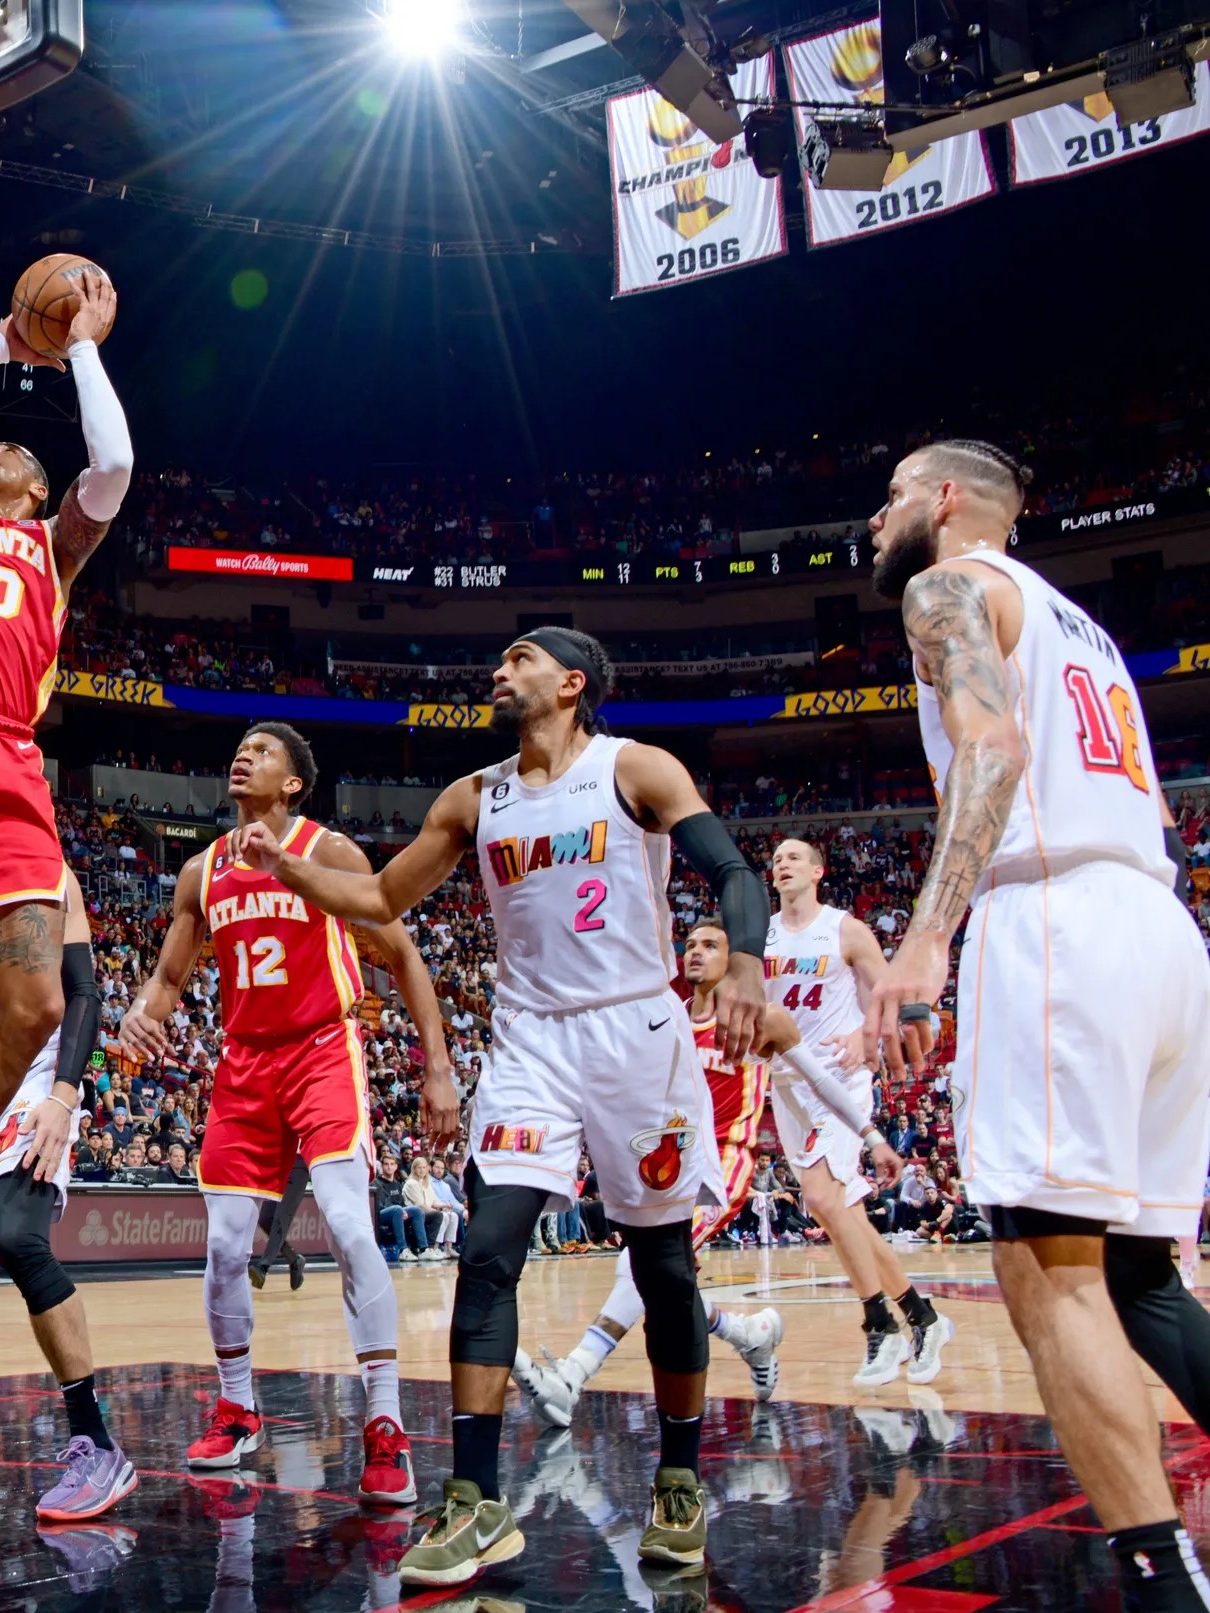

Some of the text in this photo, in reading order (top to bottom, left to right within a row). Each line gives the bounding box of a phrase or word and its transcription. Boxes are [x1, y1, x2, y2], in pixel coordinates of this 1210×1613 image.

[1064, 116, 1162, 168] 2013
[856, 179, 944, 229] 2012
[656, 237, 741, 281] 2006
[20, 378, 33, 391] 66
[1061, 502, 1155, 532] PLAYER STATS
[215, 554, 309, 575] WATCH Bally SPORTS
[809, 552, 833, 565] AST
[434, 566, 507, 577] #22 BUTLER
[617, 562, 630, 573] 12
[656, 566, 679, 579] PTS
[694, 560, 701, 572] 7
[729, 561, 755, 574] REB
[373, 567, 415, 581] HEAT
[582, 568, 604, 580] MIN
[434, 576, 501, 587] #31 STRUS
[673, 664, 694, 673] TEXT
[697, 664, 708, 672] US
[710, 663, 722, 671] AT
[90, 671, 157, 704] GREEK
[568, 781, 598, 795] UKG
[165, 826, 197, 839] BACARDÍ
[215, 856, 223, 869] 6
[208, 891, 310, 934] ATLANTA
[574, 878, 607, 933] 2
[233, 936, 288, 989] 12
[783, 984, 823, 1011] 44
[111, 1209, 207, 1246] StateFarm
